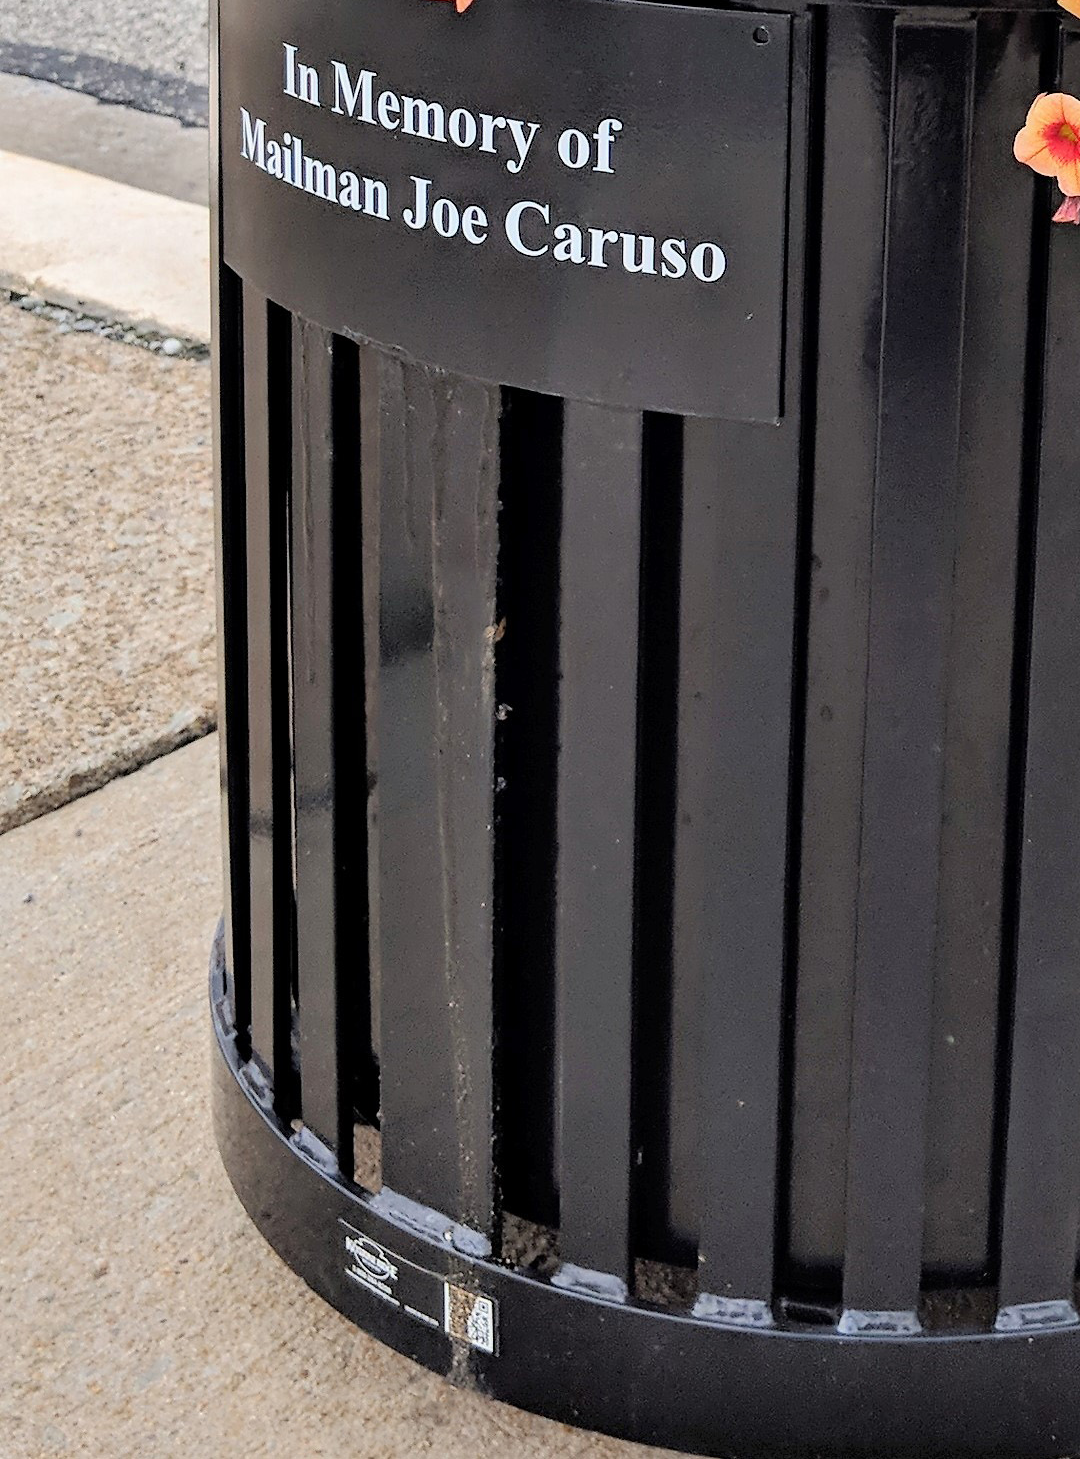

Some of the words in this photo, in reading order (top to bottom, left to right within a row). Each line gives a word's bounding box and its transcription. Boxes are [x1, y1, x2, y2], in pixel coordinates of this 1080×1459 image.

[282, 42, 321, 107] In
[330, 60, 541, 174] Memory
[557, 118, 623, 174] of
[239, 106, 390, 221] Mailman
[402, 175, 489, 245] Joe
[504, 201, 727, 283] Caruso
